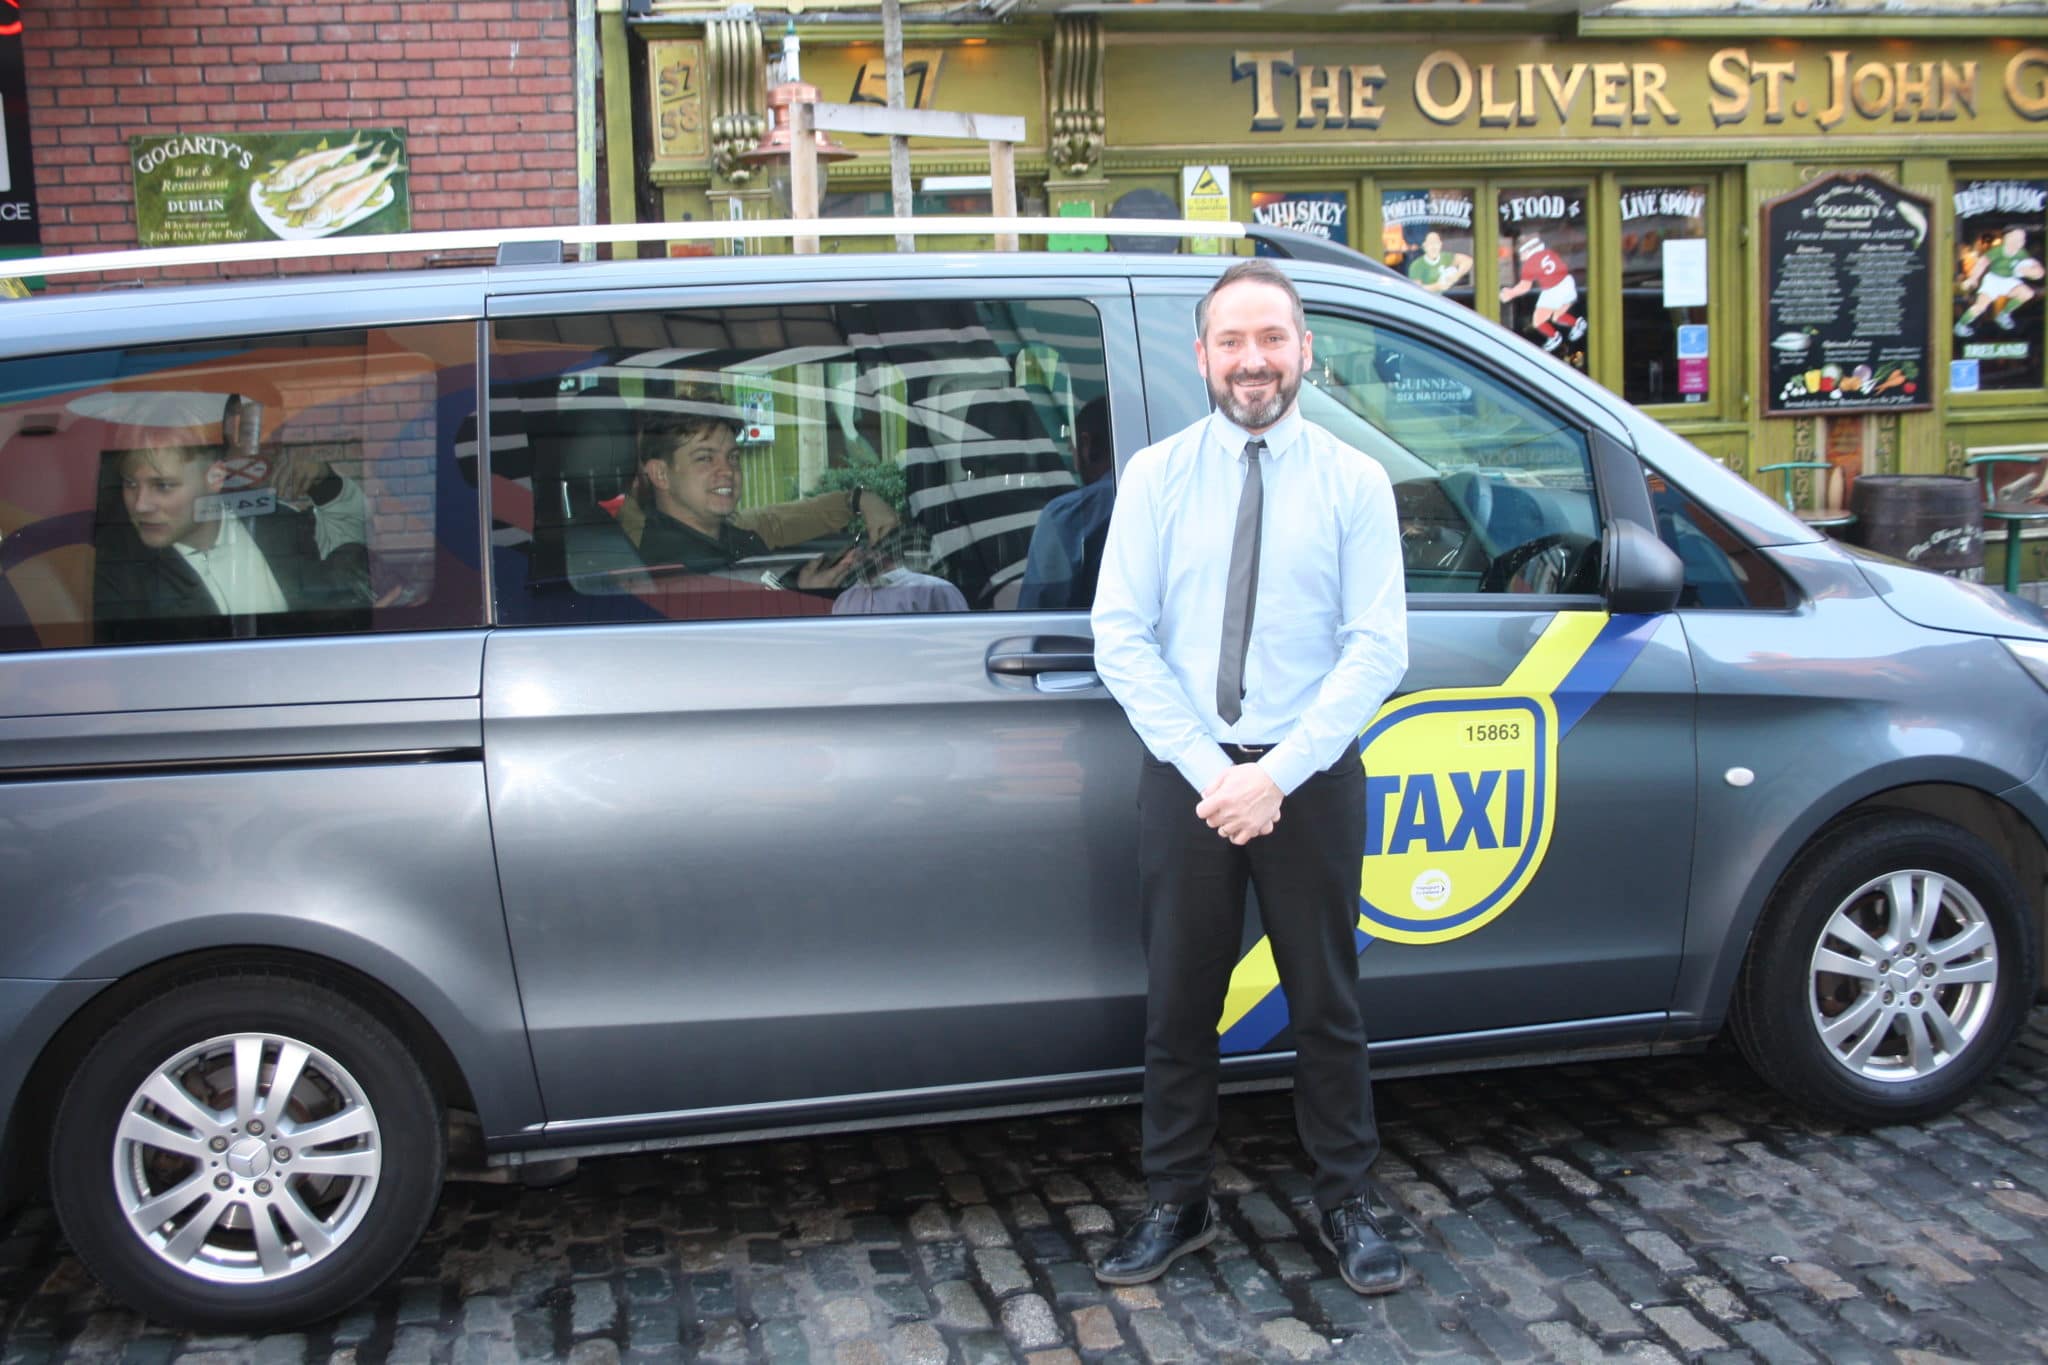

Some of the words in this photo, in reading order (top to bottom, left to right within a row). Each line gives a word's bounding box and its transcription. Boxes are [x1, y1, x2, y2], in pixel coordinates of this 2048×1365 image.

[1232, 49, 1387, 132] THE
[1413, 49, 1680, 128] OLIVER
[1708, 47, 1808, 128] ST.
[1815, 49, 1979, 132] JOHN
[138, 138, 254, 173] GOGARTY'S
[175, 164, 198, 178] Bar
[201, 164, 212, 177] &
[161, 178, 229, 193] Restaurant
[0, 203, 32, 221] CE
[167, 199, 224, 213] DUBLIN
[1253, 200, 1347, 227] WHISKEY
[1510, 196, 1565, 221] FOOD
[1620, 193, 1658, 221] LIVE
[1659, 192, 1705, 217] SPORT
[172, 230, 194, 241] Dish
[1540, 255, 1556, 274] 5
[1416, 391, 1463, 400] NATIONS
[1465, 723, 1520, 742] 15863
[1362, 768, 1525, 856] TAXI
